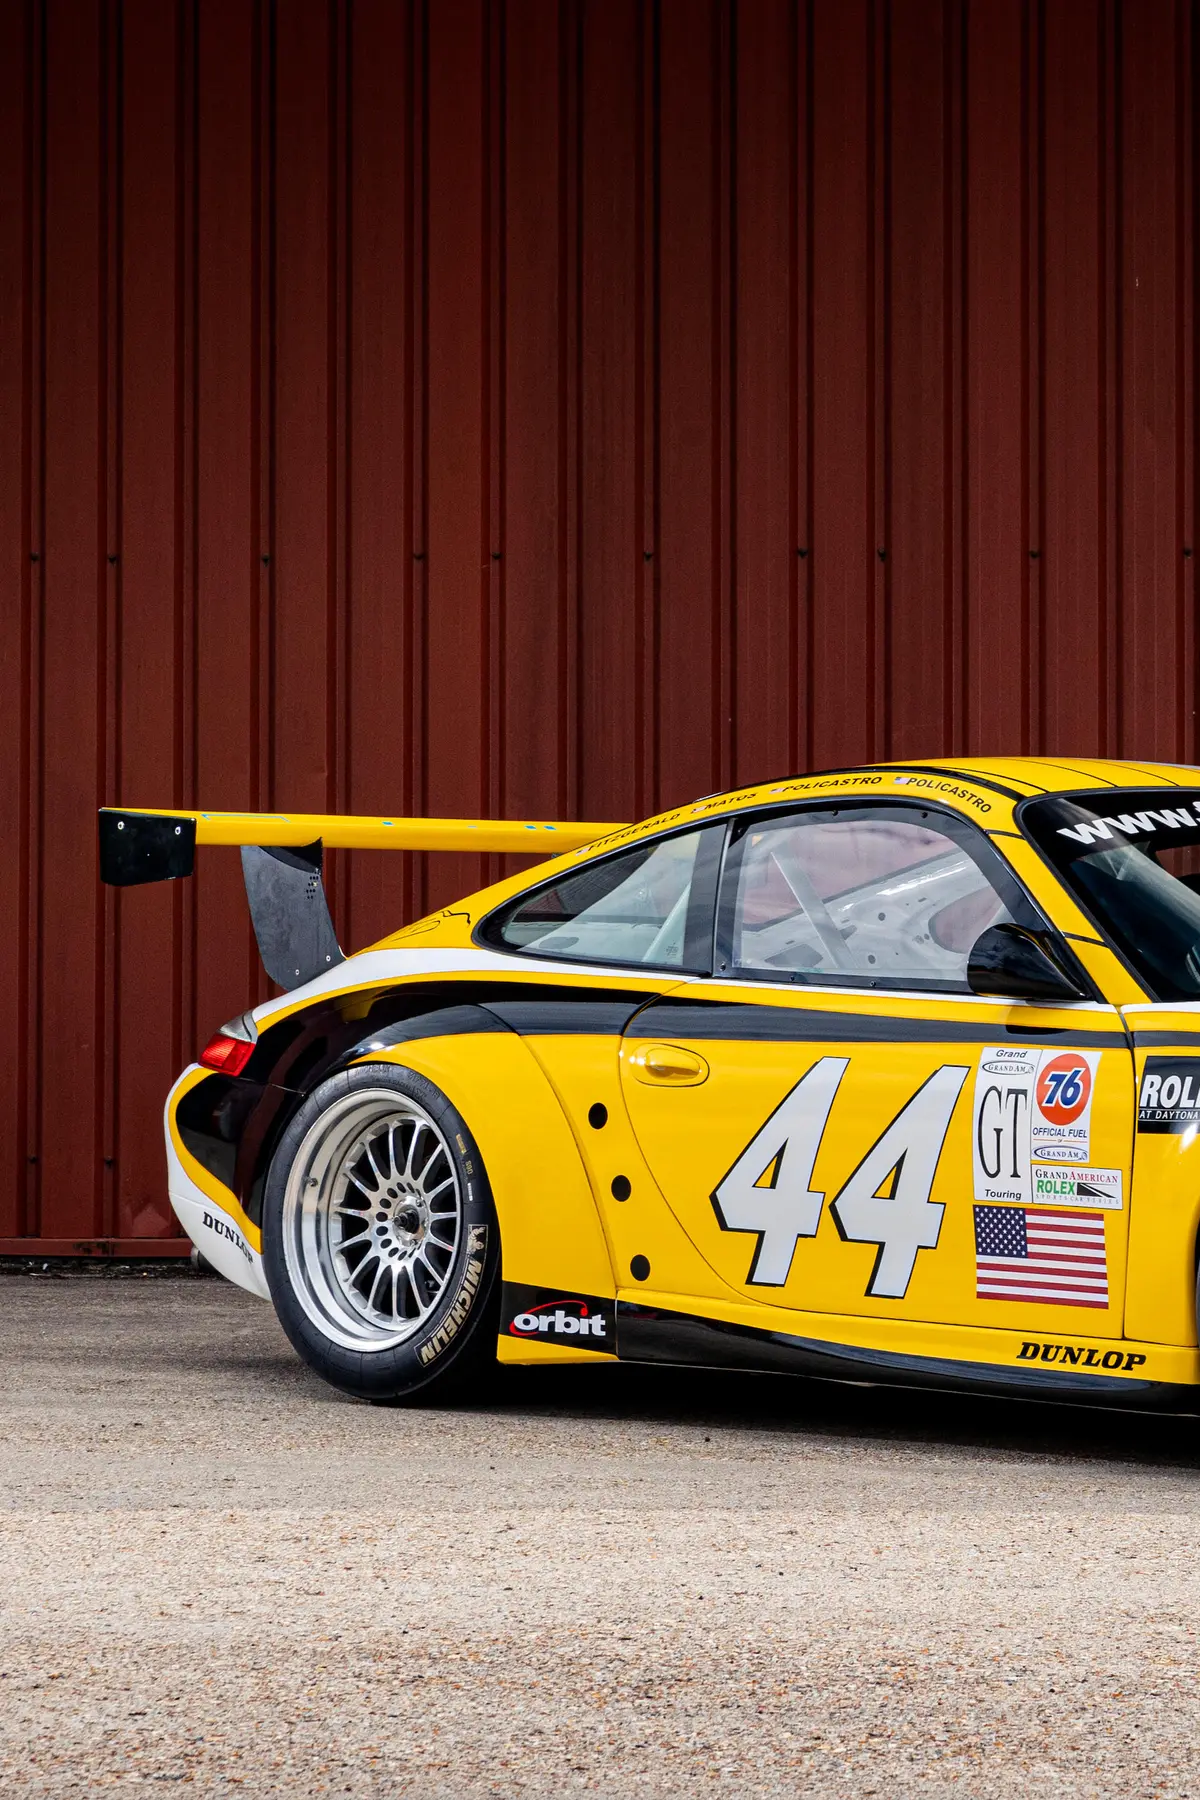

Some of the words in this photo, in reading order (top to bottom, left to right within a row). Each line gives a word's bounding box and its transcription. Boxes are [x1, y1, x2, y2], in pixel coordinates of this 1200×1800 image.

[782, 776, 883, 792] POLICASTRO
[905, 777, 992, 814] POLICASTRO
[704, 793, 758, 810] MATOS
[588, 813, 681, 852] FITZGERALD
[996, 1049, 1028, 1059] Grand
[1042, 1067, 1086, 1109] 76
[1139, 1110, 1150, 1119] AT
[1155, 1110, 1198, 1119] DAYTONA
[978, 1085, 1028, 1179] GT
[1032, 1127, 1066, 1137] OFFICIAL
[1068, 1128, 1087, 1138] FUEL
[709, 1056, 971, 1299] 44
[1035, 1168, 1068, 1180] GRAND
[1069, 1171, 1118, 1183] AMERICAN
[1036, 1179, 1076, 1195] ROLEX
[985, 1188, 1022, 1201] Touring
[202, 1211, 254, 1264] DUNLOP
[420, 1259, 482, 1364] MICHELIN
[513, 1308, 607, 1337] orbit
[1016, 1341, 1147, 1371] DUNLOP
